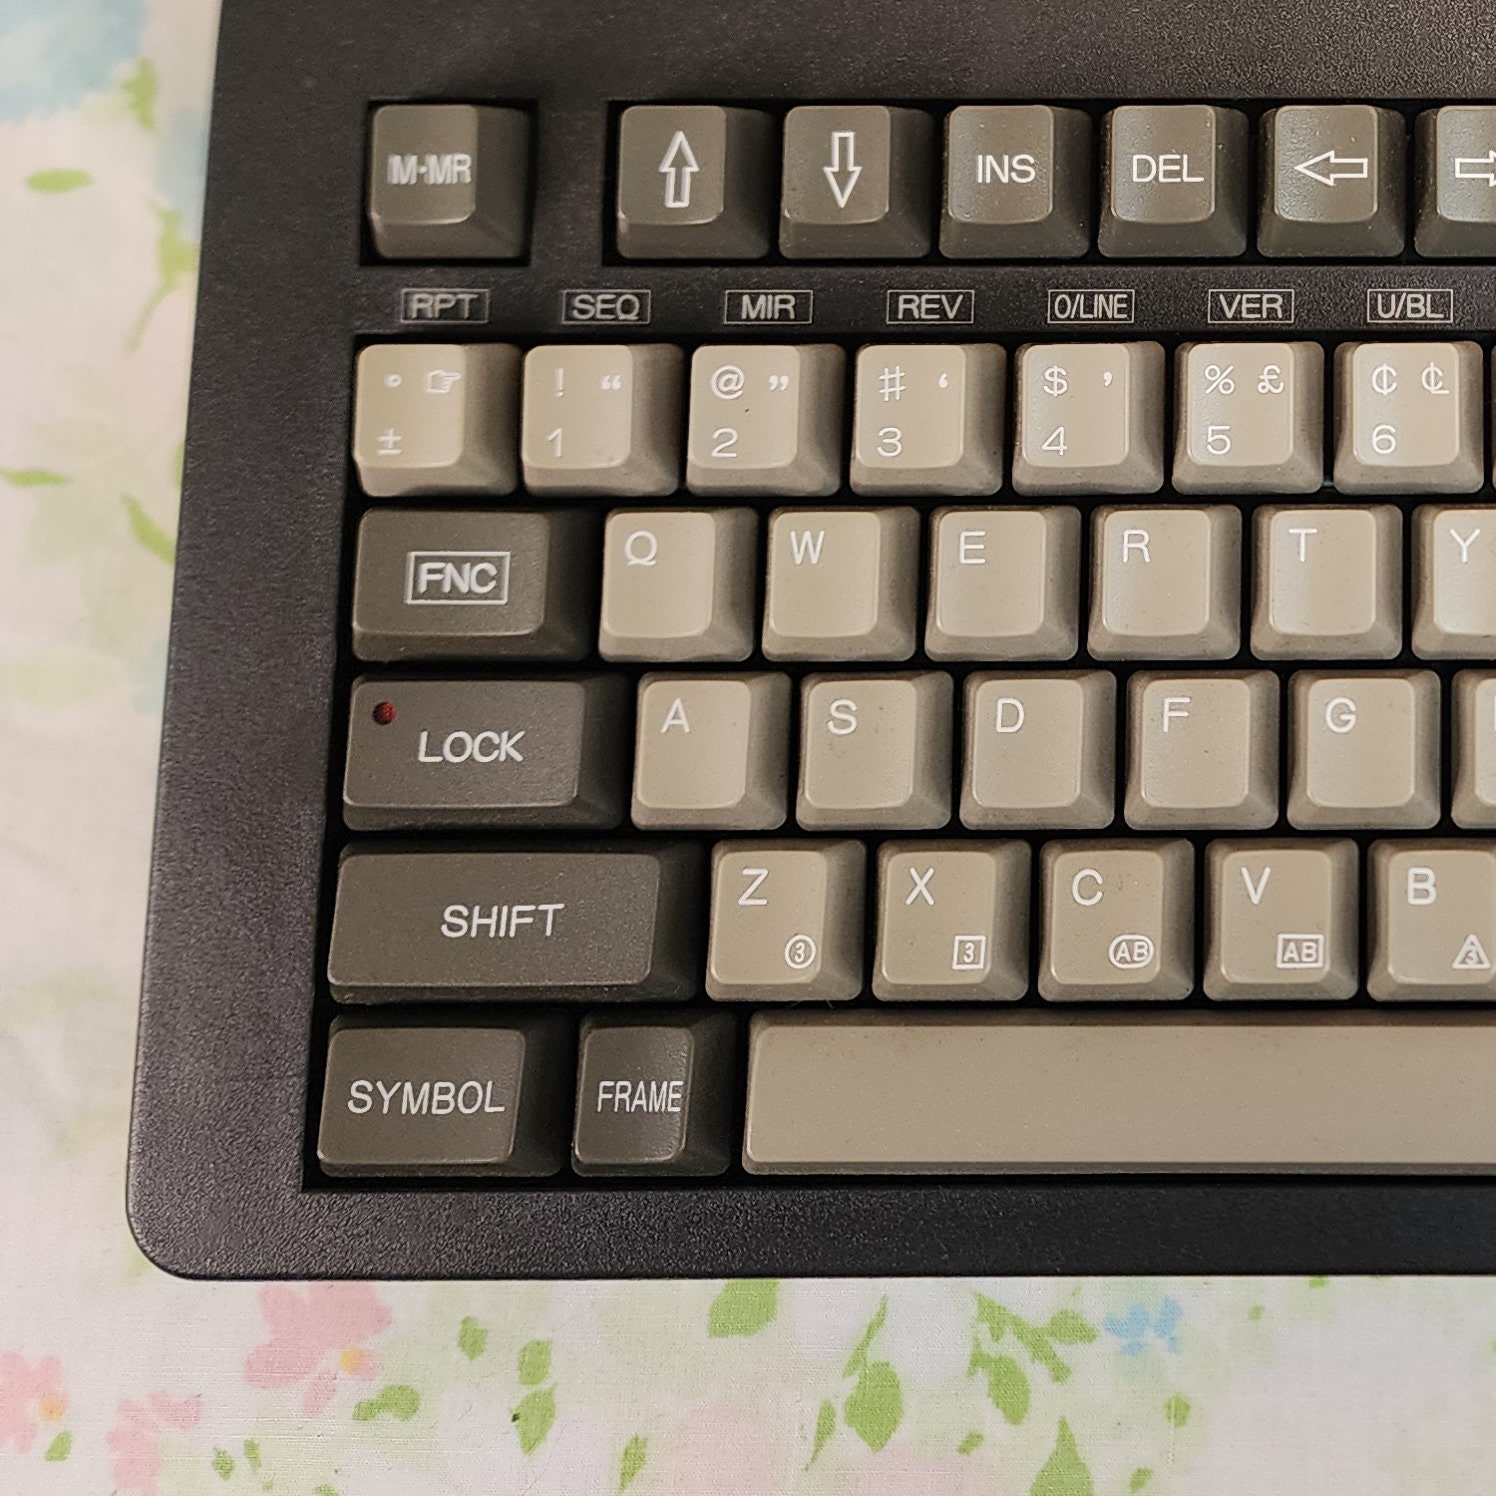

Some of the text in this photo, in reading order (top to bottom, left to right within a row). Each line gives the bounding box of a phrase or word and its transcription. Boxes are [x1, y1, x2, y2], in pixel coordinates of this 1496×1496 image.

[976, 154, 1036, 184] INS
[1133, 154, 1205, 184] DEL
[409, 294, 479, 319] RPT
[572, 295, 641, 321] SEQ
[741, 294, 796, 319] MIR
[897, 294, 964, 319] REV
[1054, 294, 1128, 319] O/LINE
[1218, 294, 1283, 318] VER
[1376, 294, 1445, 319] U/BL
[710, 365, 745, 399] @
[1042, 365, 1068, 396] $
[1204, 365, 1235, 395] %
[546, 428, 564, 457] 1
[711, 428, 738, 458] 2
[876, 428, 903, 457] 3
[1041, 426, 1068, 456] 4
[1205, 426, 1231, 456] 5
[1371, 425, 1397, 455] 6
[624, 530, 657, 566] Q
[790, 530, 825, 564] W
[959, 530, 986, 564] E
[1122, 530, 1151, 562] R
[1289, 528, 1317, 562] T
[1449, 529, 1480, 562] Y
[417, 564, 497, 594] FNC
[661, 698, 690, 733] A
[828, 700, 857, 735] S
[995, 698, 1025, 732] D
[1162, 698, 1190, 732] F
[1325, 698, 1357, 733] G
[418, 731, 525, 764] LOCK
[738, 868, 769, 905] Z
[906, 868, 935, 905] X
[1072, 869, 1103, 905] C
[1240, 867, 1271, 904] V
[1408, 868, 1435, 905] B
[441, 904, 565, 938] SHIFT
[1283, 942, 1317, 961] AB
[346, 1081, 506, 1116] SYMBOL
[597, 1081, 684, 1113] FRAME
